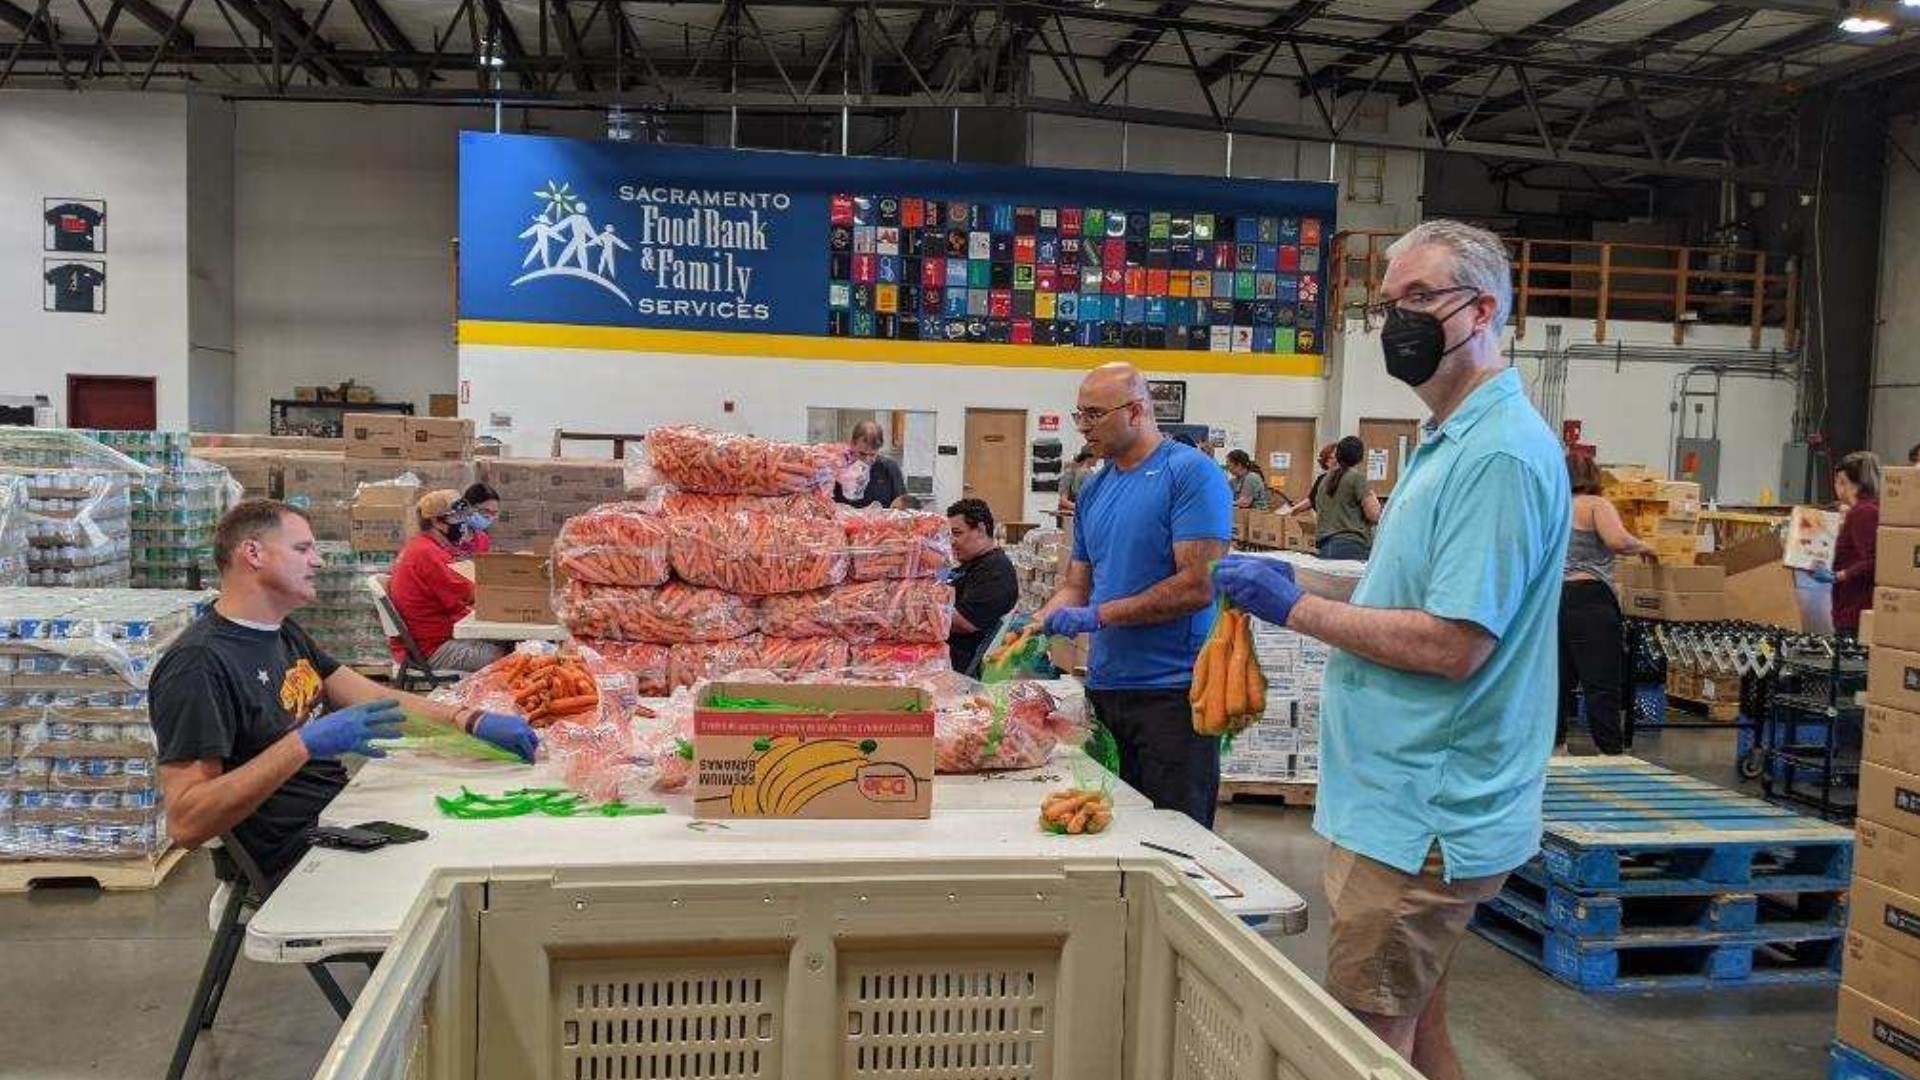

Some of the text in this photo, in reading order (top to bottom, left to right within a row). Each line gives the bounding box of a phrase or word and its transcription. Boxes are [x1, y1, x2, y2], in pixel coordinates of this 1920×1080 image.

[618, 185, 791, 210] SACRAMENTO
[640, 204, 769, 250] Food Bank
[654, 248, 753, 304] Family
[638, 298, 770, 320] SERVICES
[699, 759, 756, 772] BANANAS
[699, 772, 756, 786] PREMIUM
